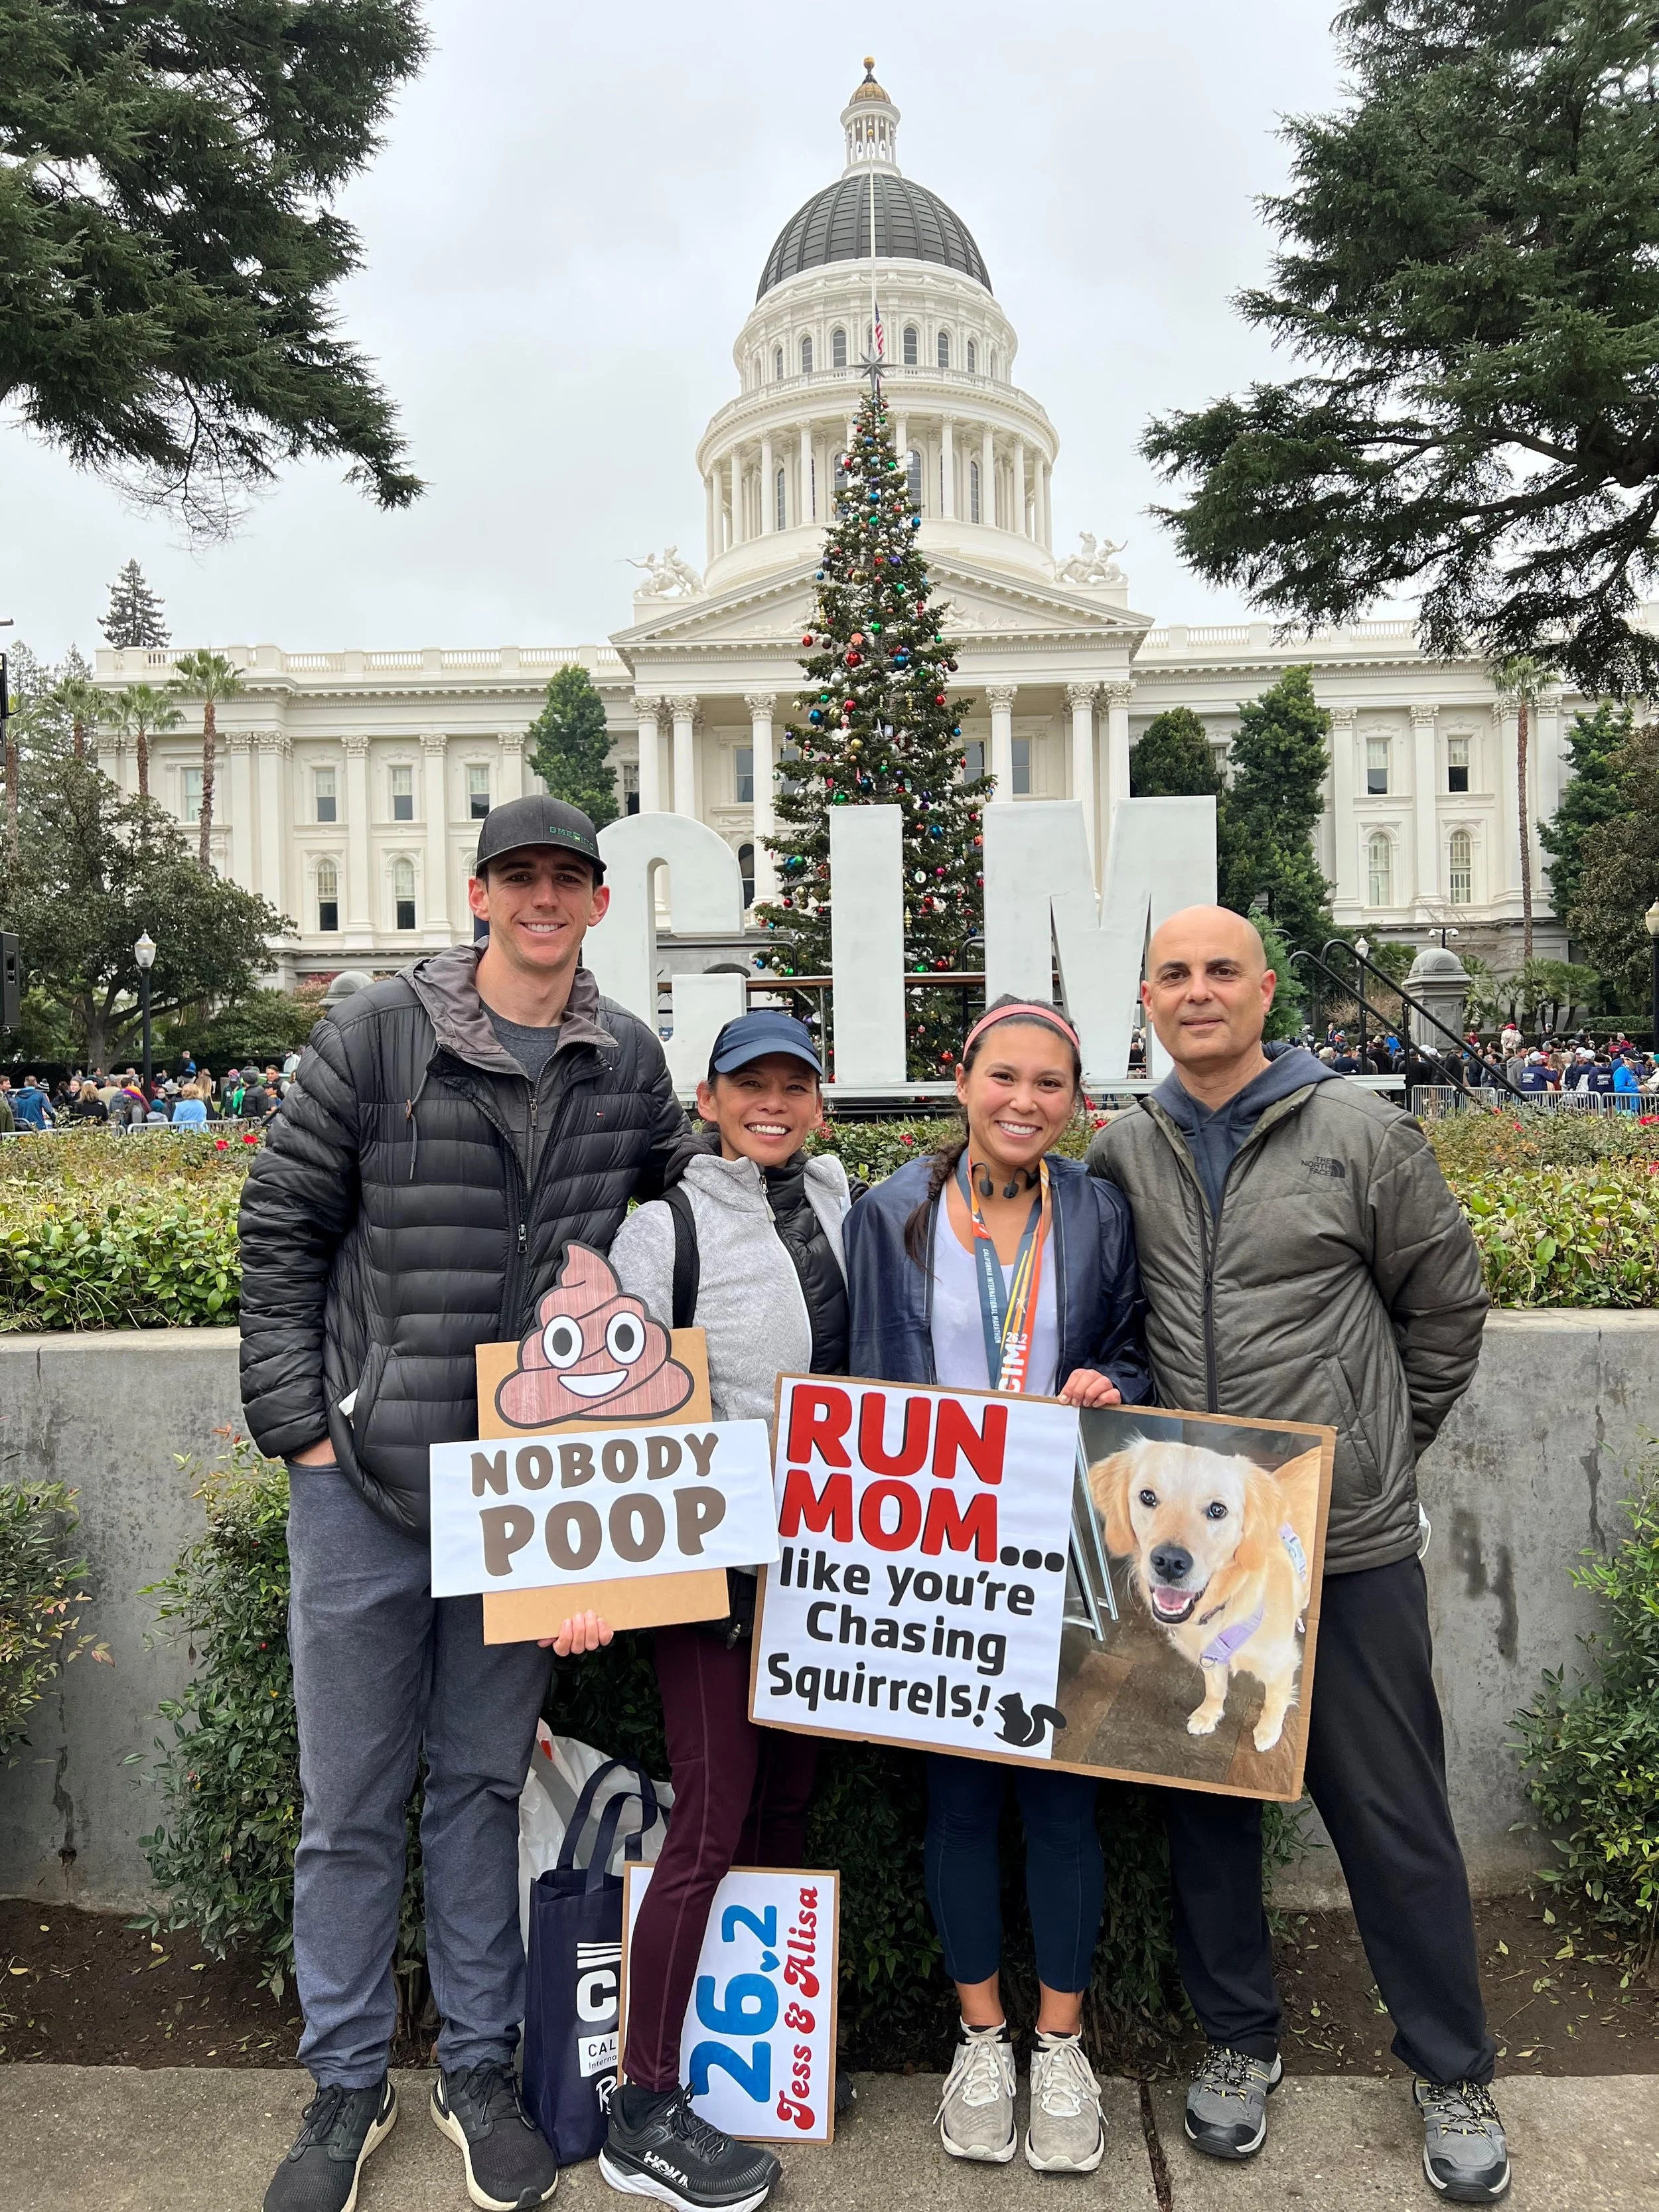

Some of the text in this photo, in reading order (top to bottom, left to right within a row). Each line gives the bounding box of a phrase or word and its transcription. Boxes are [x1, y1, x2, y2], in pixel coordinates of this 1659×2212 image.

[583, 795, 1217, 1087] CIM
[1301, 1159, 1331, 1170] NORTH
[1309, 1167, 1331, 1176] FACE
[1315, 1155, 1332, 1164] THE
[983, 1248, 1001, 1344] CALIFORNIA INTERNATIONAL MARATHON
[998, 1343, 1027, 1392] CIM
[1005, 1331, 1028, 1345] 26.2
[470, 1432, 719, 1497] NOBODY
[786, 1383, 1008, 1485] RUN
[478, 1486, 727, 1578] POOP
[778, 1469, 1065, 1573] MOM...
[780, 1546, 1035, 1616] like you're
[806, 1601, 1007, 1676] Chasing
[767, 1653, 991, 1728] Squirrels!
[776, 1885, 820, 2130] Jess & Alisa
[643, 2150, 689, 2189] HOKA
